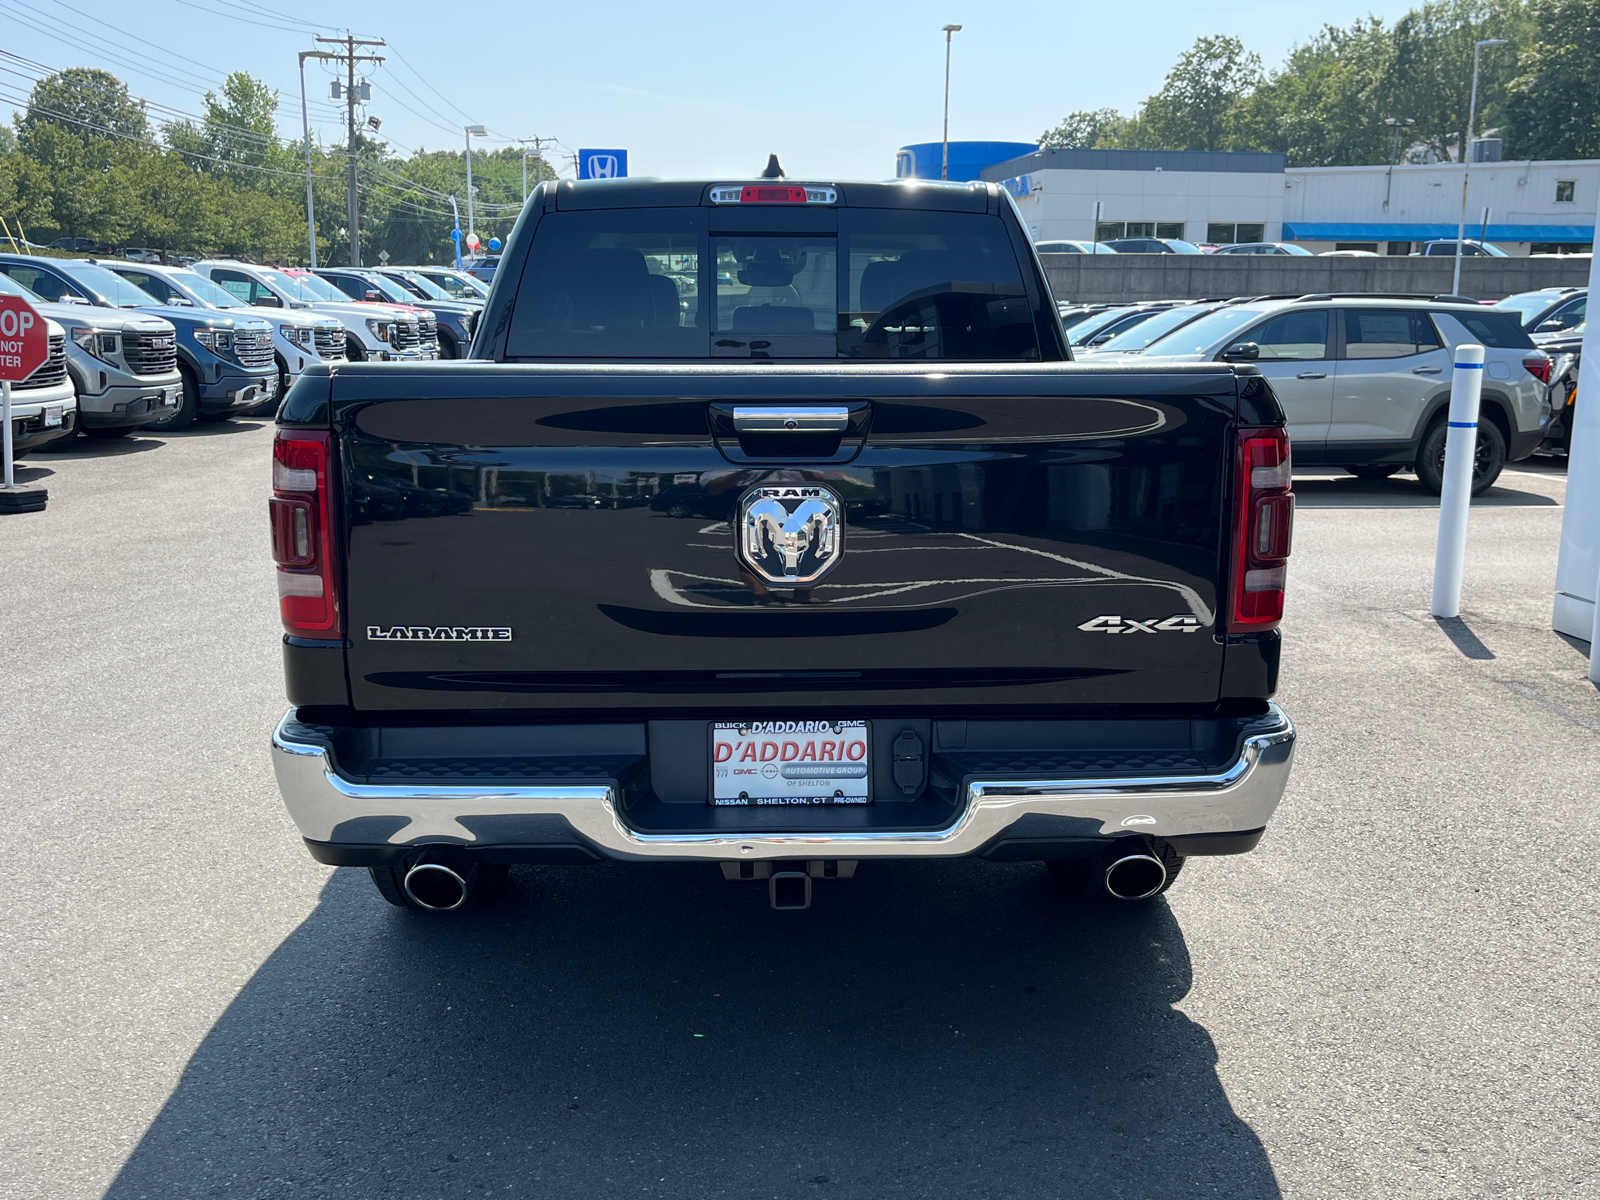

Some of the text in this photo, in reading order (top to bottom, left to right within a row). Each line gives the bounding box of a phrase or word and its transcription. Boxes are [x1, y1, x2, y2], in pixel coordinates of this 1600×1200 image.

[0, 309, 34, 337] OP
[1, 341, 24, 353] NOT
[761, 488, 821, 498] RAM
[367, 626, 512, 641] LARAMIE
[751, 721, 830, 734] D'ADDARIO
[713, 740, 866, 762] D'ADDARIO
[785, 766, 864, 775] AUTOMOTIVE GROUP
[797, 779, 831, 787] SHELTON
[715, 798, 748, 806] NISSAN
[756, 797, 810, 805] SHELTON,
